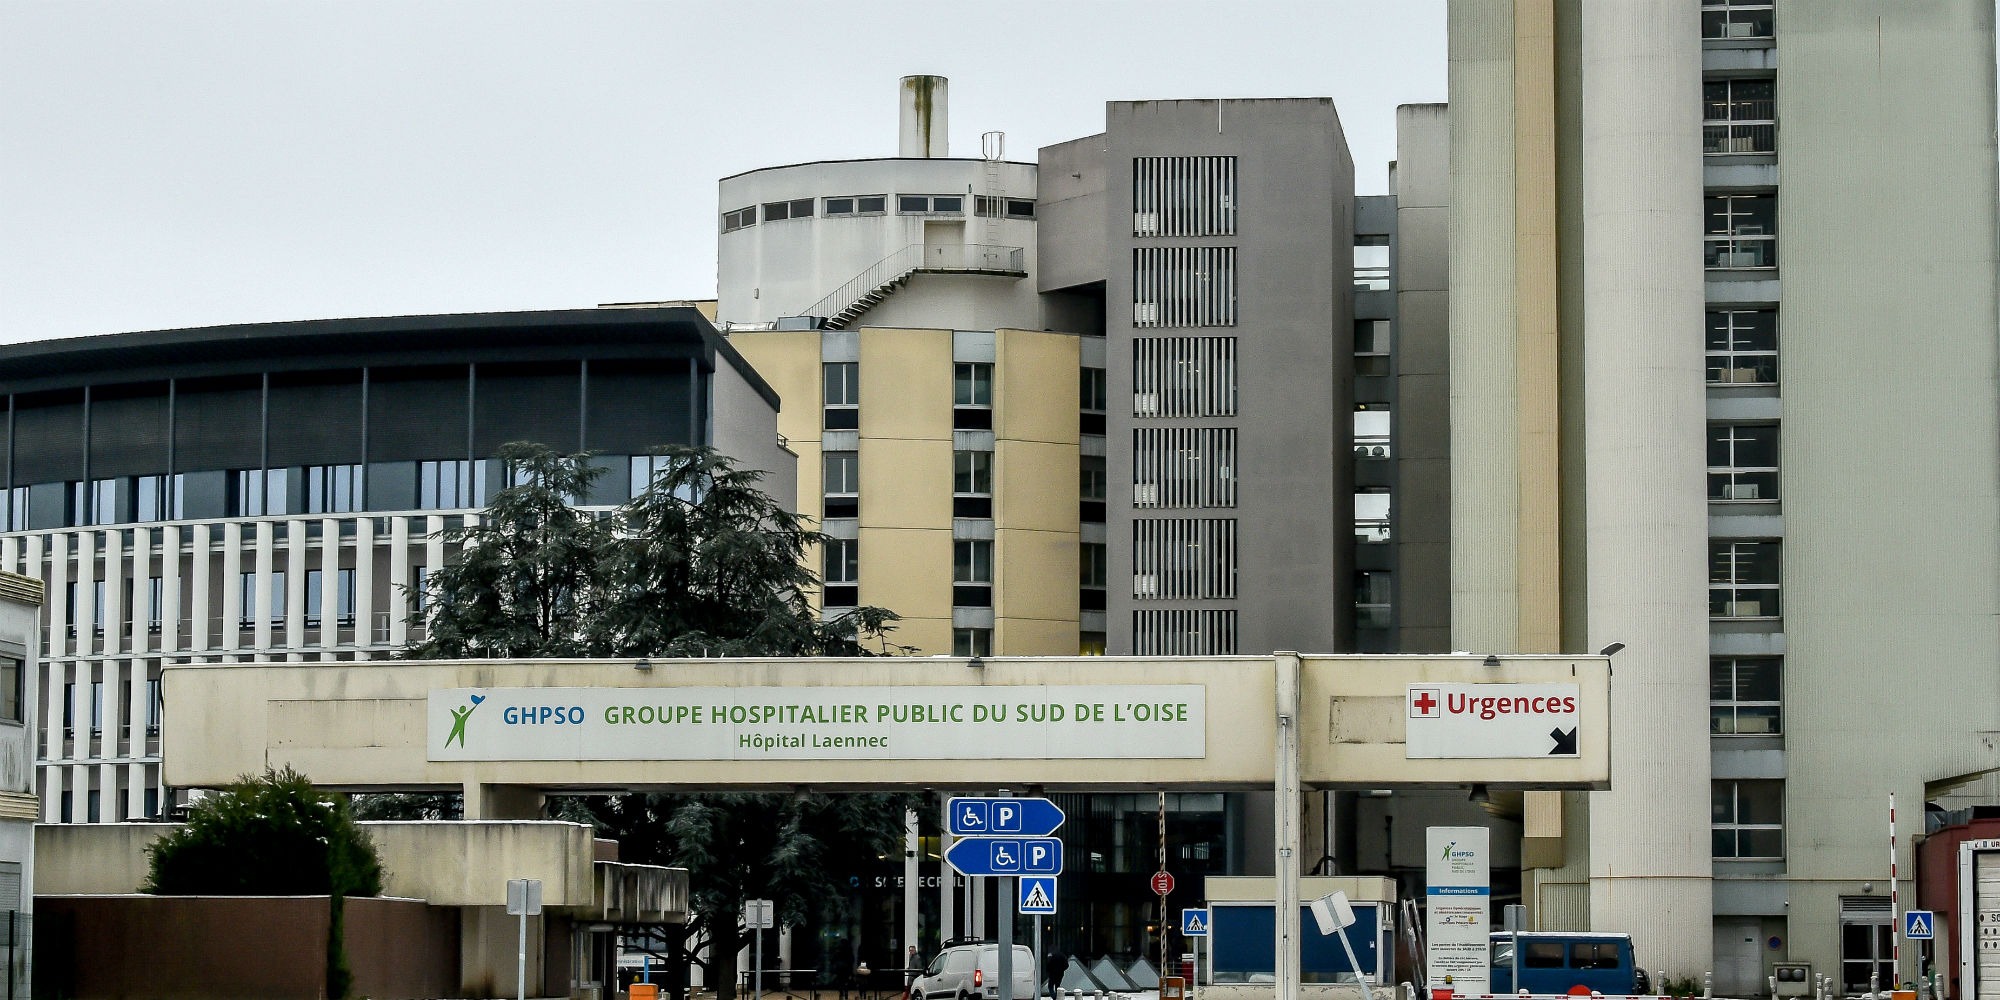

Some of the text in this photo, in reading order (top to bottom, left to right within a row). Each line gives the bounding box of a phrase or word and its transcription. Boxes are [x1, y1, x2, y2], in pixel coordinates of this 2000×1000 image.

[503, 705, 585, 725] GHPSO
[604, 705, 703, 725] GROUPE
[711, 705, 868, 724] HOSPITALIER
[877, 705, 964, 723] PUBLIC
[973, 704, 1007, 723] DU
[1016, 704, 1065, 723] SUD
[1075, 703, 1104, 722] DE
[1448, 693, 1576, 721] Urgences
[739, 733, 888, 752] Hôpital Laennec
[1000, 807, 1013, 826] P
[1032, 846, 1046, 866] P
[1157, 873, 1168, 895] STOP
